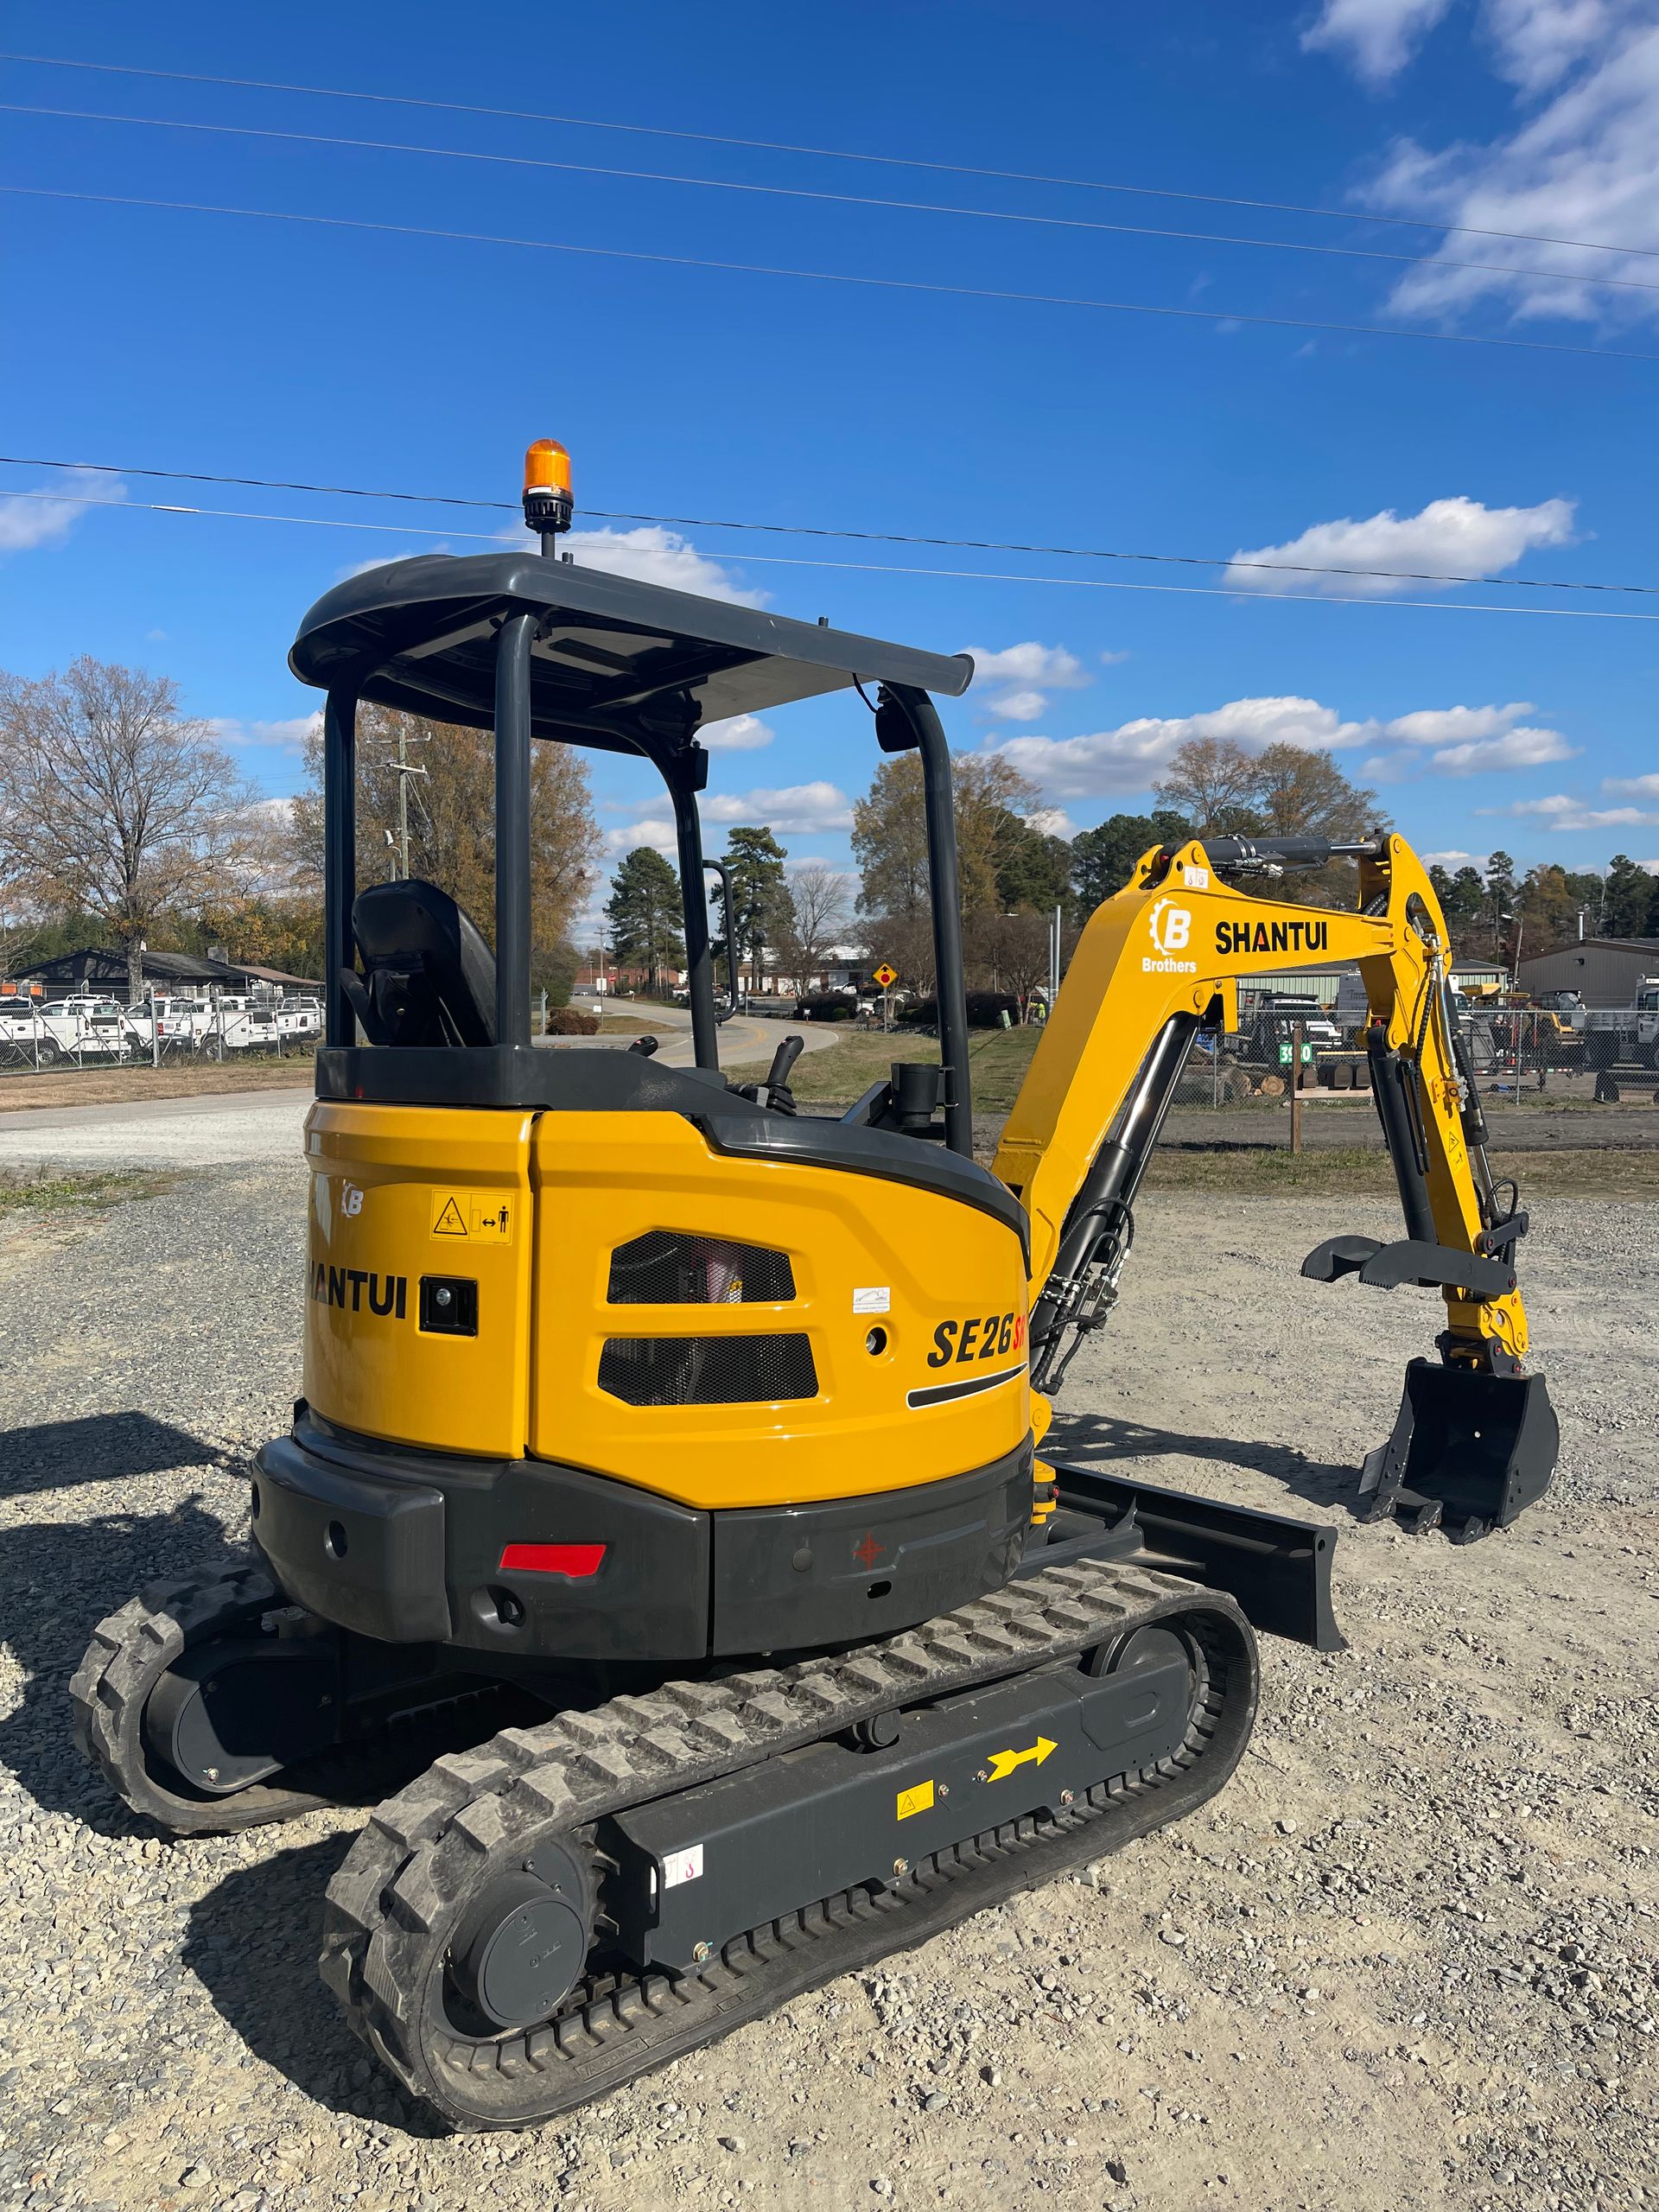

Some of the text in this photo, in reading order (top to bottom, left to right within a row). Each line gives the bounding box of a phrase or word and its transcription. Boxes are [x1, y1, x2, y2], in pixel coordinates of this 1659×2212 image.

[1215, 921, 1327, 954] SHANTUI
[1142, 957, 1197, 974] Brothers
[1281, 1046, 1311, 1062] 390
